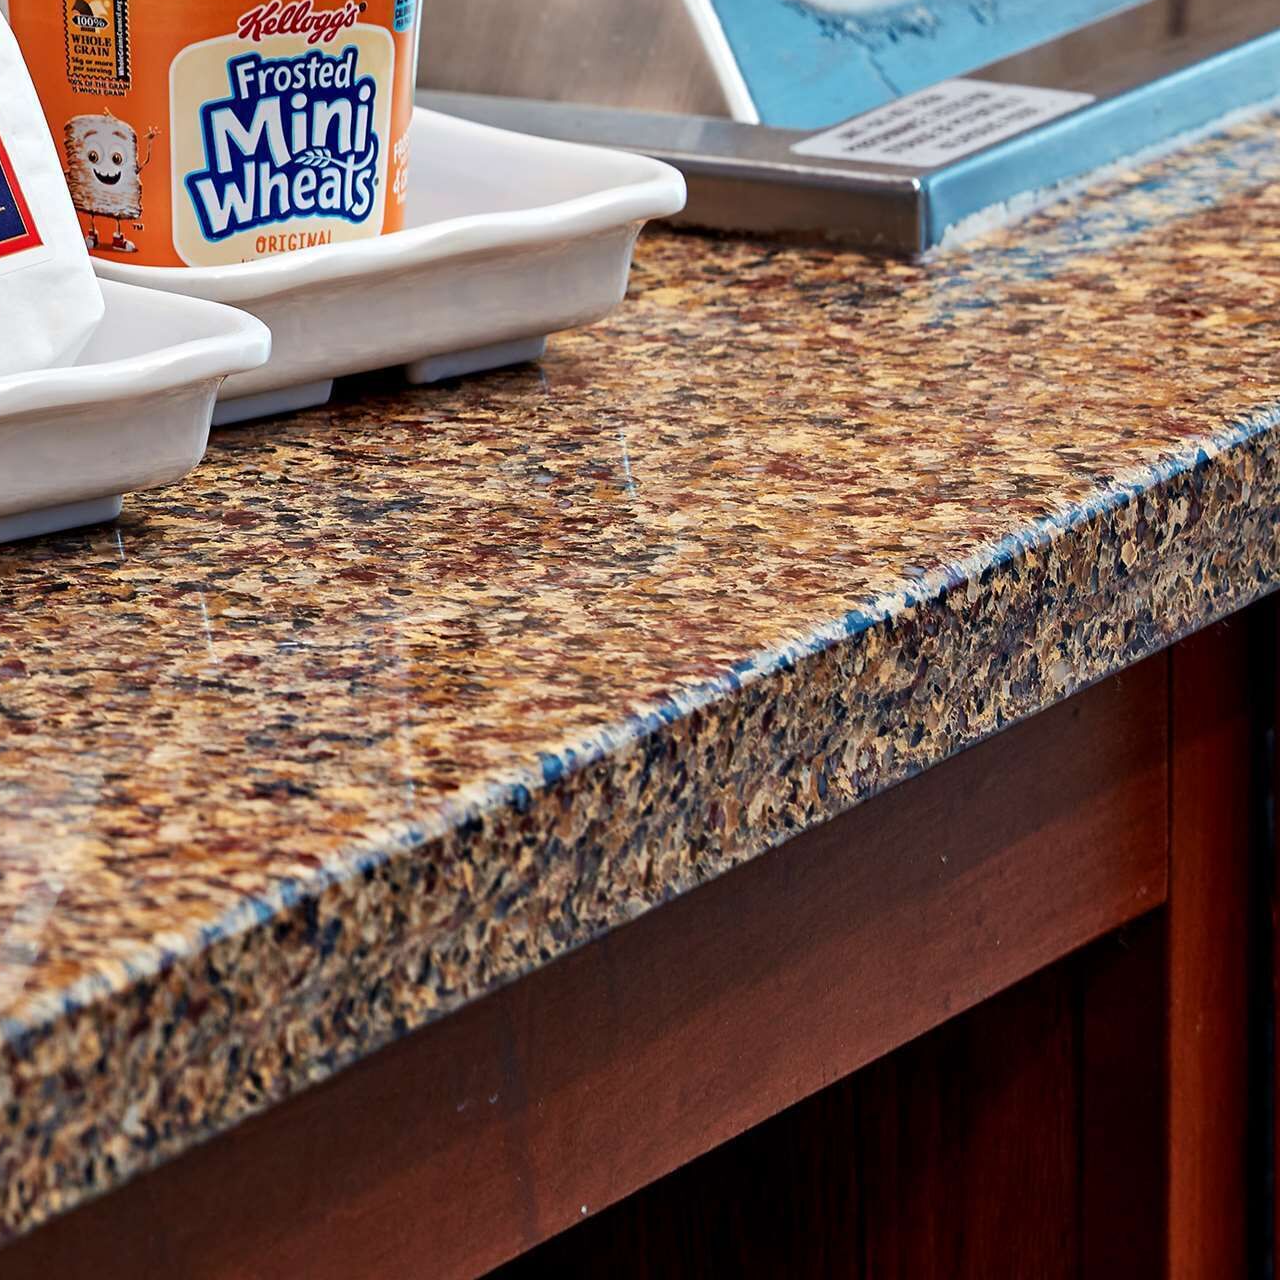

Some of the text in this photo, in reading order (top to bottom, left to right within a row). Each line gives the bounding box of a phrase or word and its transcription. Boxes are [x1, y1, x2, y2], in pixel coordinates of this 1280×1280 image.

[76, 16, 106, 27] 100%
[238, 0, 358, 44] Kellogg's
[71, 33, 112, 47] WHOLE
[74, 44, 110, 56] GRAIN
[86, 67, 113, 75] serving
[236, 57, 354, 99] Frosted
[210, 85, 370, 173] Mini
[197, 141, 374, 233] Wheats
